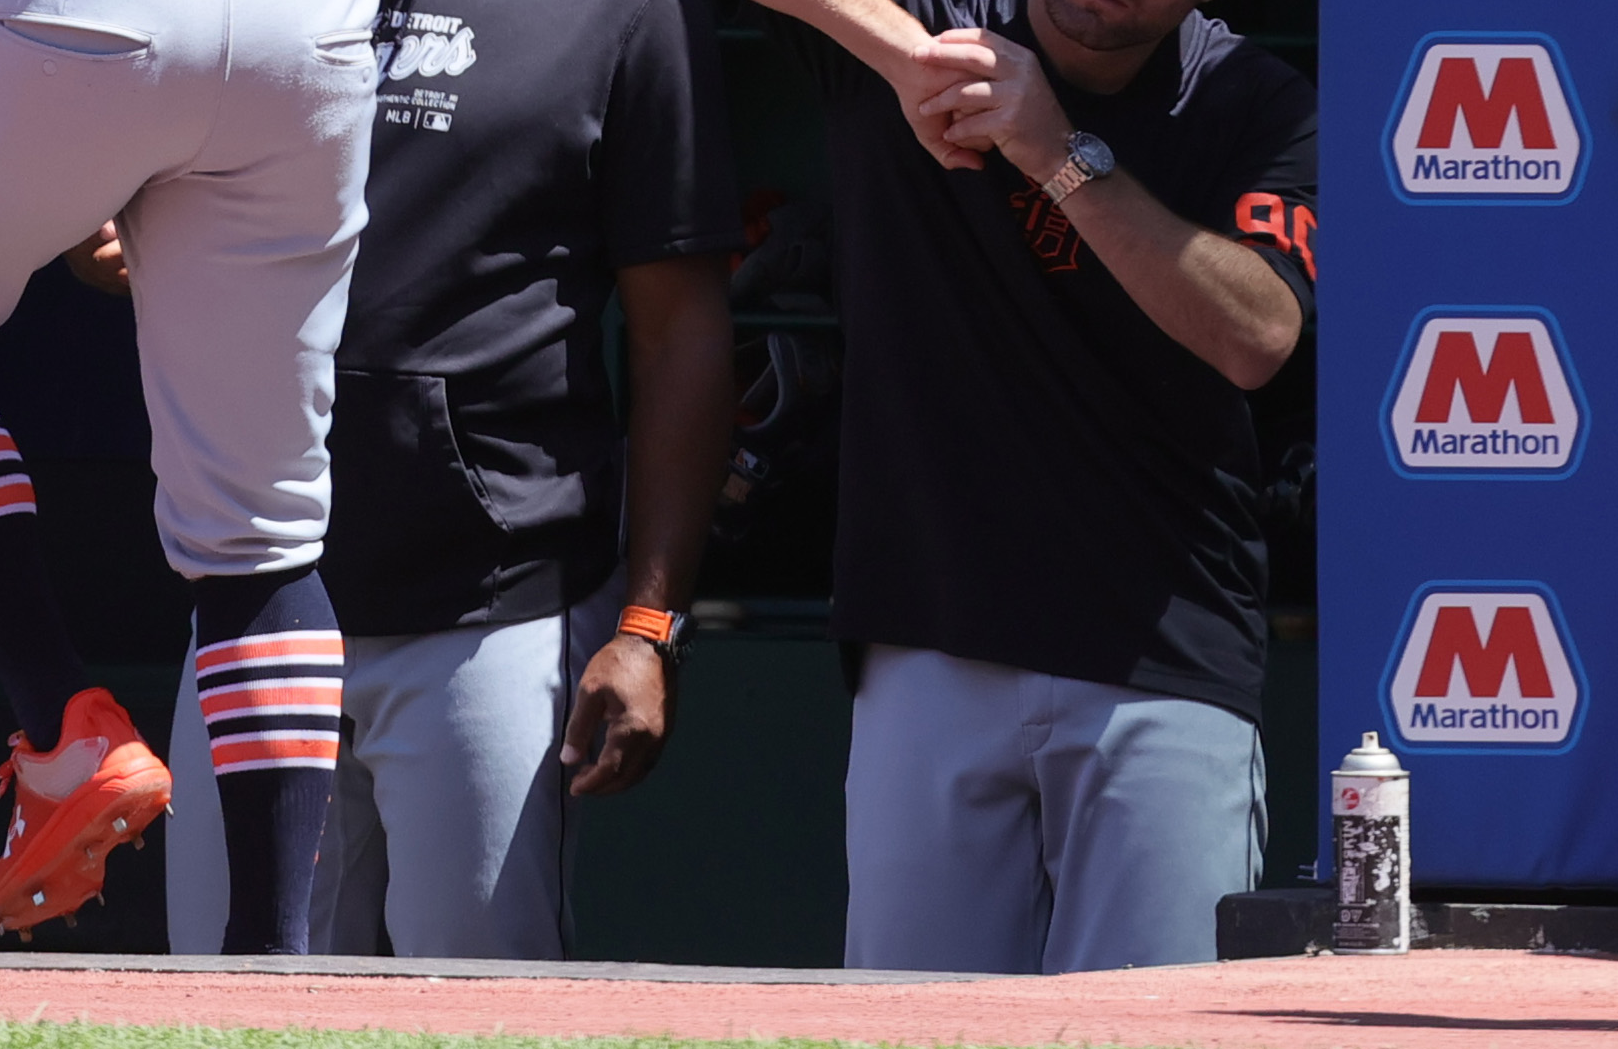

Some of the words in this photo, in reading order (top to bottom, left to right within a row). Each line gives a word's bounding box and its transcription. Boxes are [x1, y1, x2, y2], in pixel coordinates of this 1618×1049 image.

[391, 10, 462, 34] DETROIT
[411, 95, 457, 111] COLLECTION
[1418, 57, 1556, 150] M
[1412, 155, 1561, 181] Marathon
[1416, 331, 1555, 424] M
[1411, 429, 1560, 455] Marathon
[1415, 606, 1554, 699] M
[1411, 703, 1559, 730] Marathon
